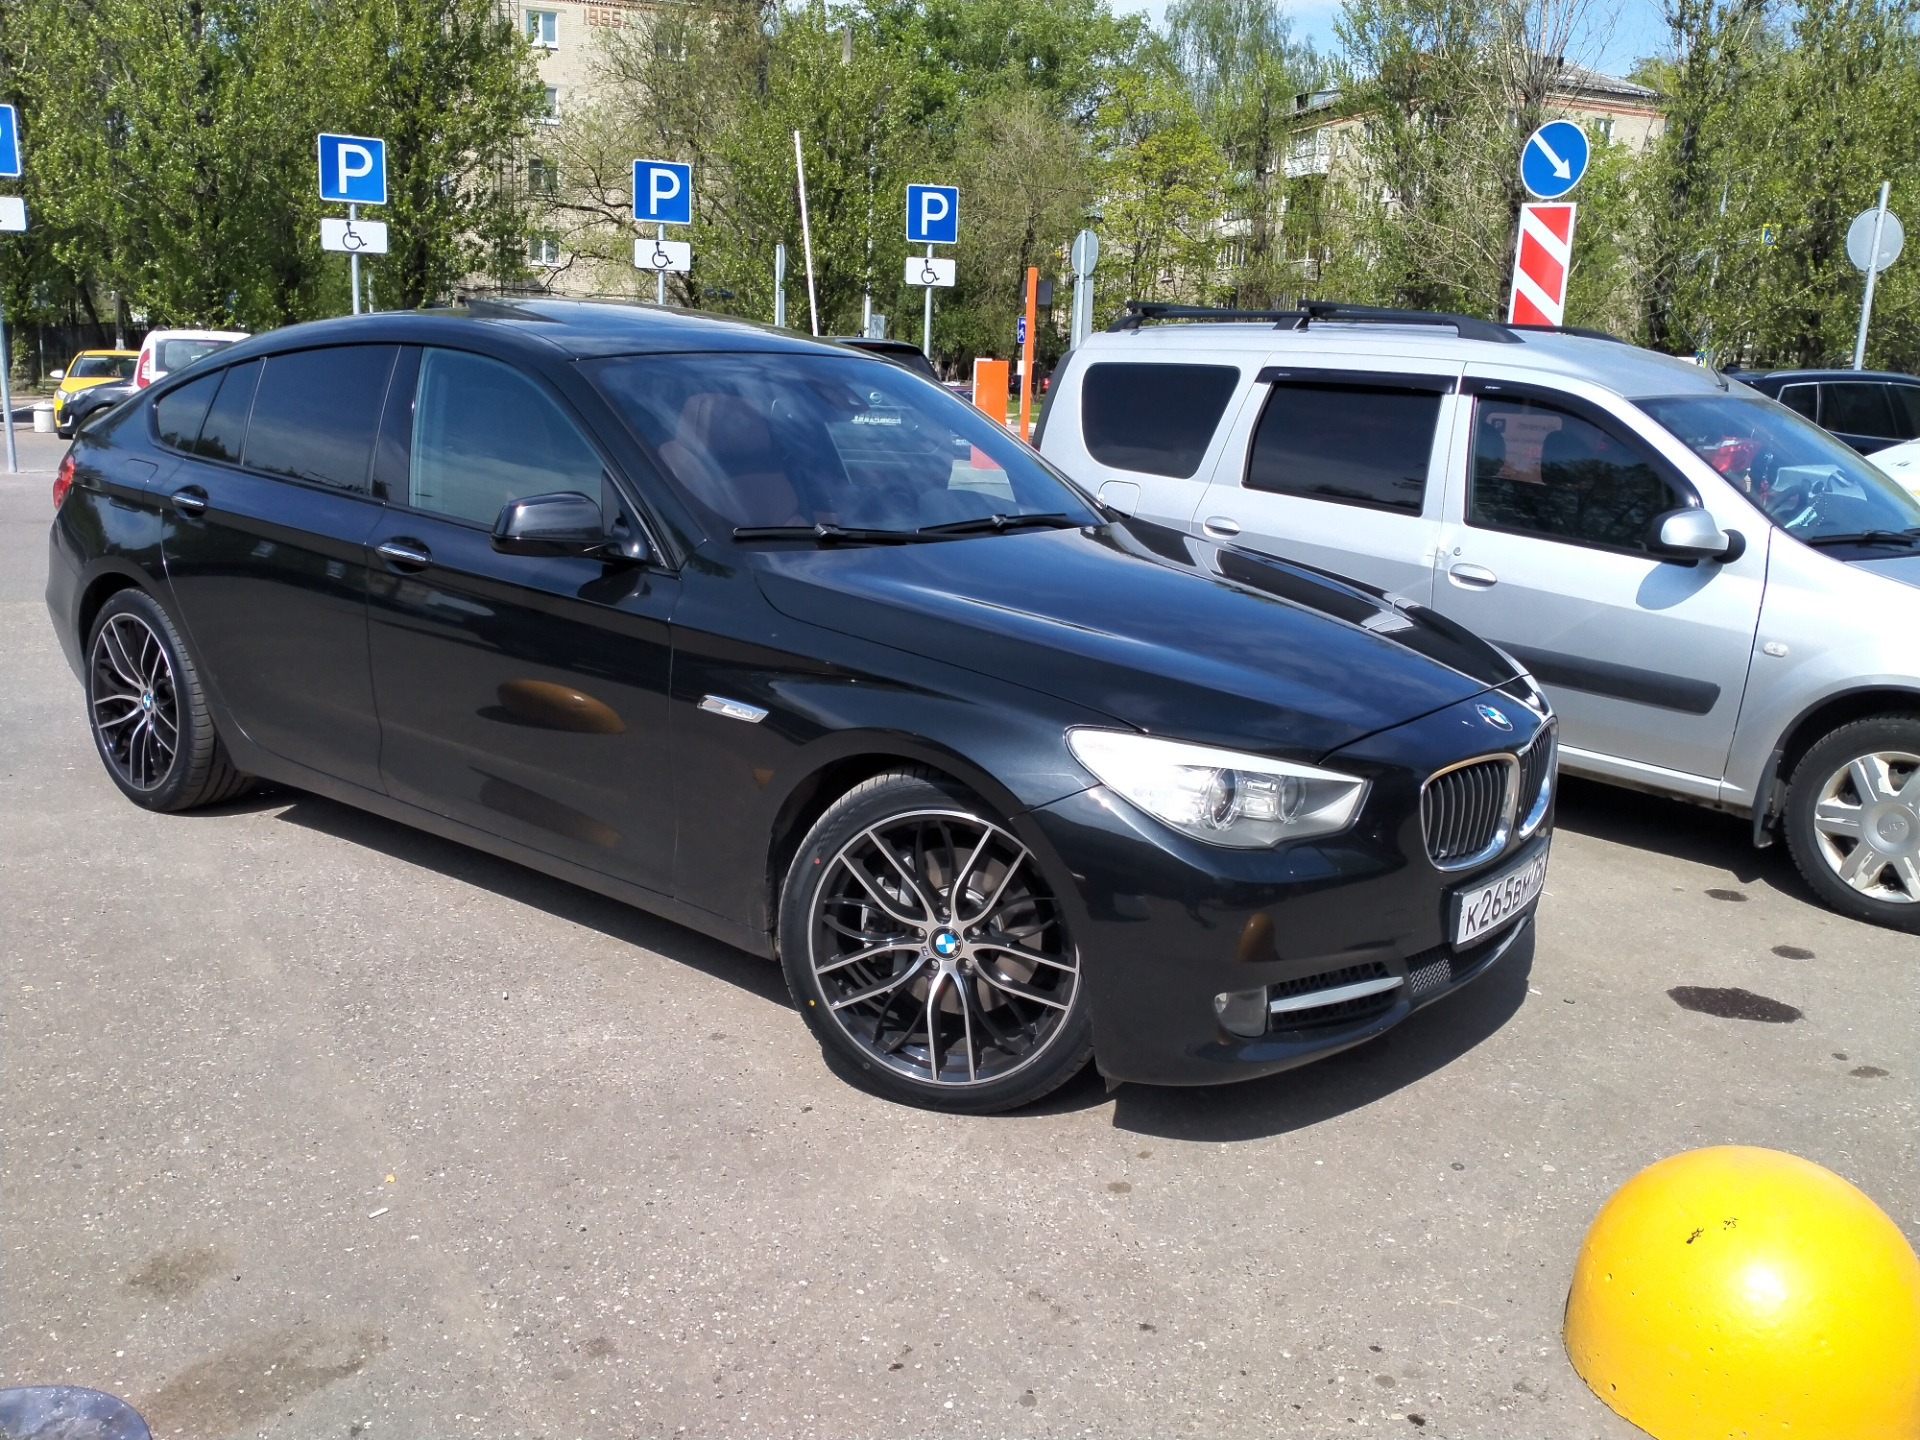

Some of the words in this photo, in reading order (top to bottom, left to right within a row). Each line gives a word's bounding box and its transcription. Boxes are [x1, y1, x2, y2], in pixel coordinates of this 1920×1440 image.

[337, 143, 373, 194] P
[650, 167, 681, 215] P
[921, 191, 949, 236] P
